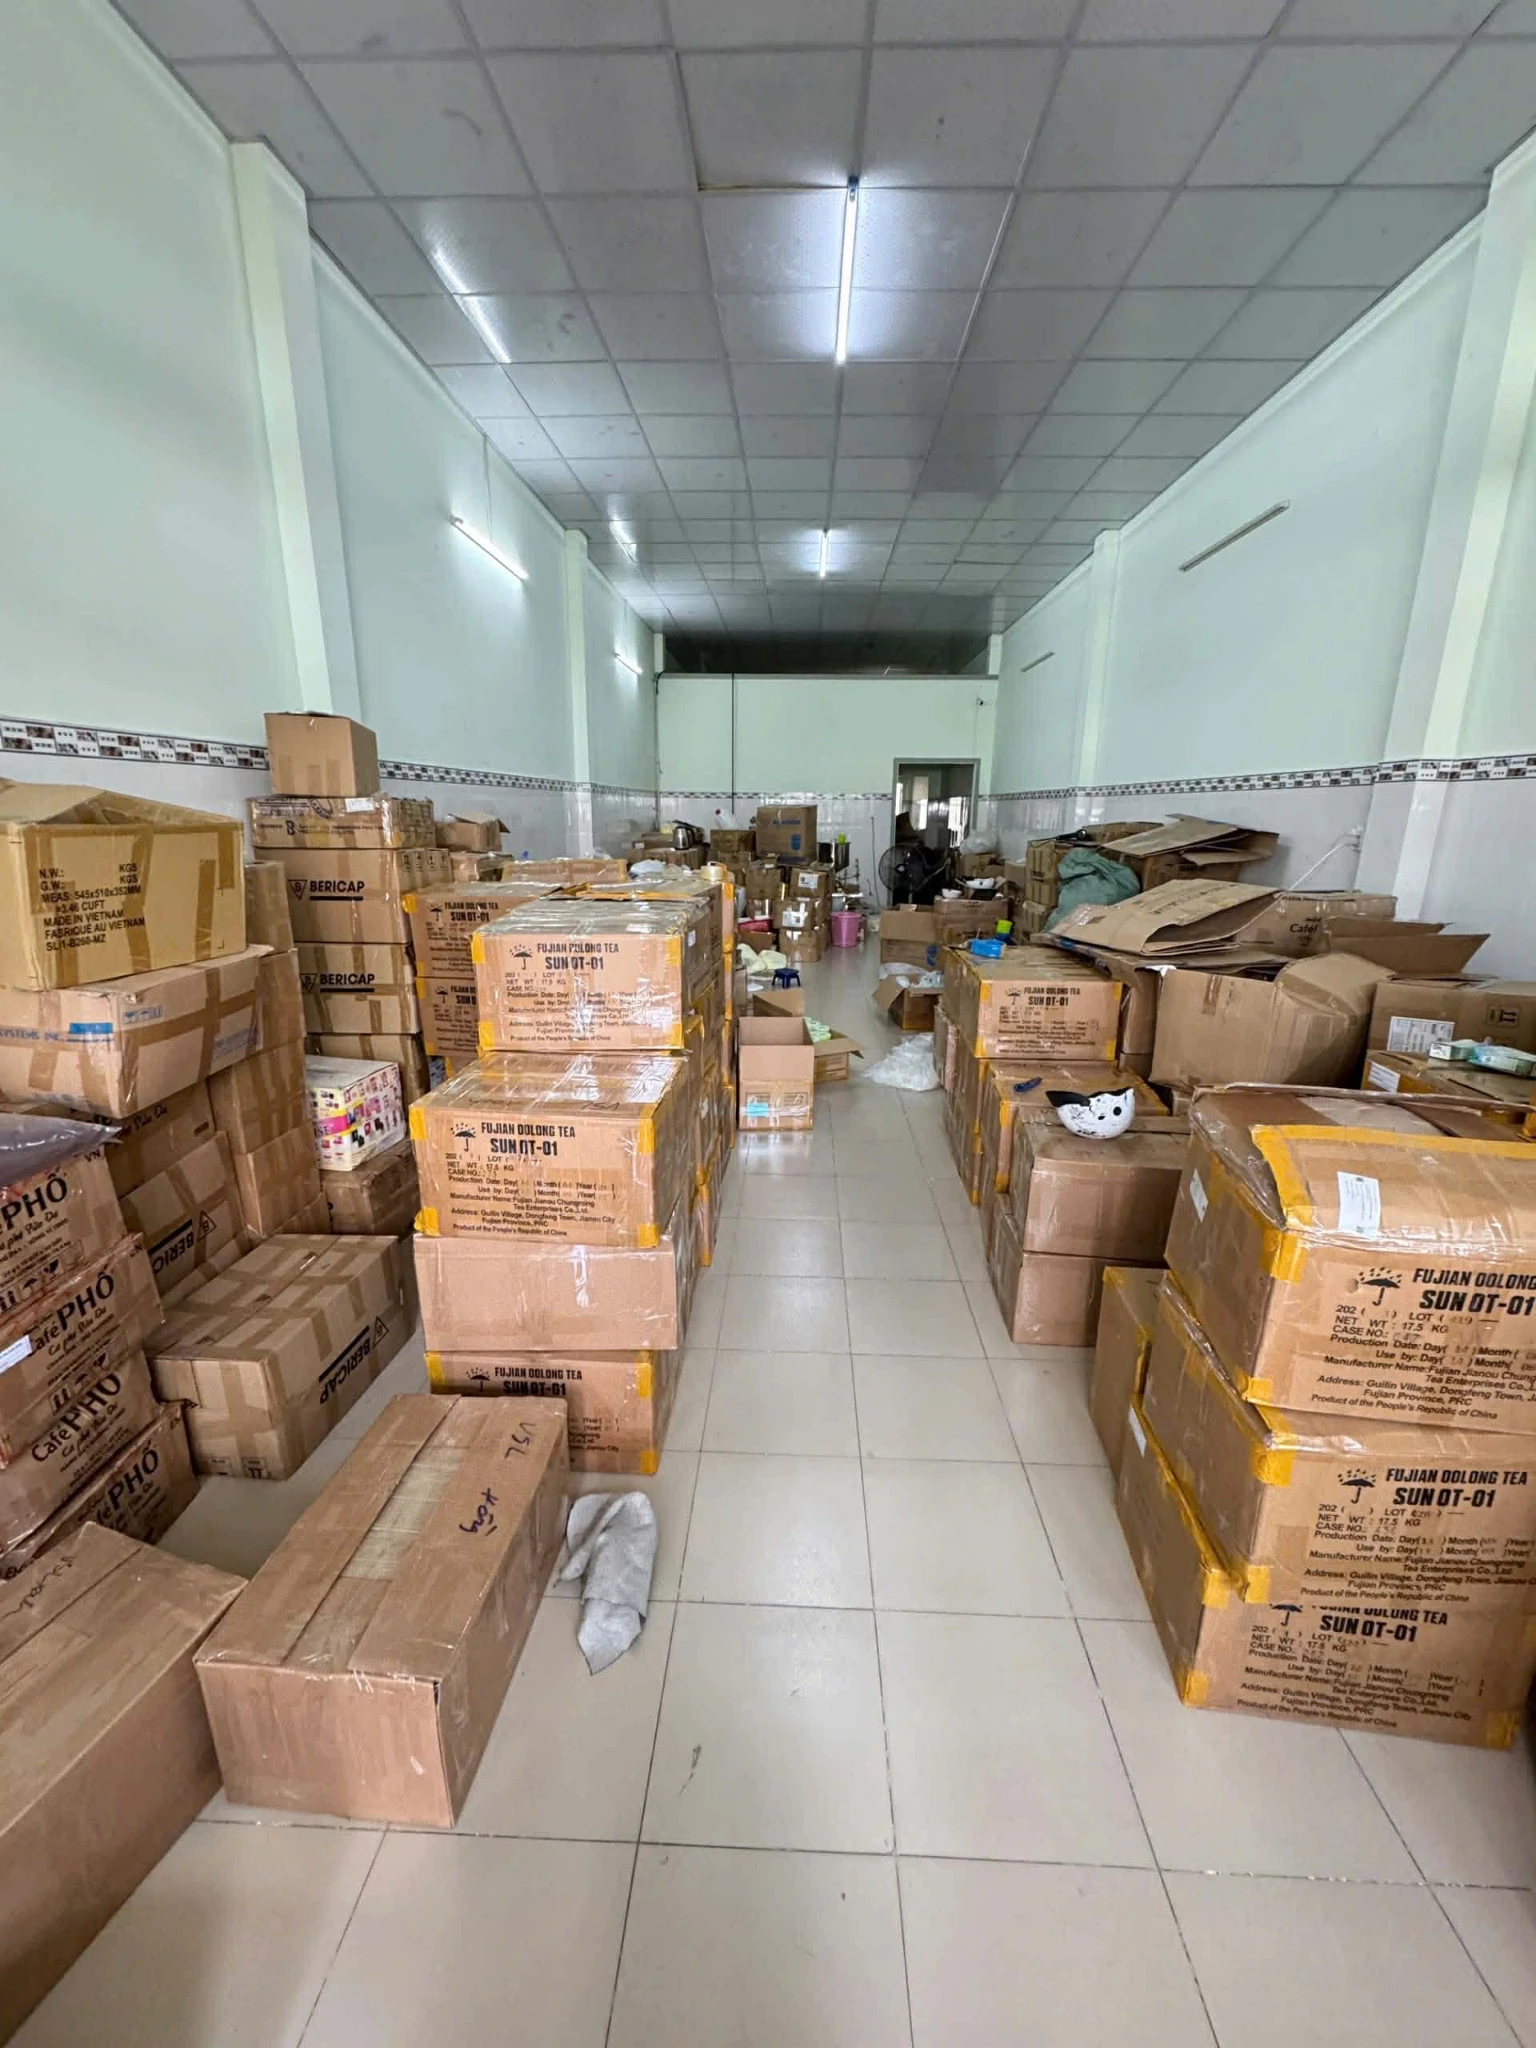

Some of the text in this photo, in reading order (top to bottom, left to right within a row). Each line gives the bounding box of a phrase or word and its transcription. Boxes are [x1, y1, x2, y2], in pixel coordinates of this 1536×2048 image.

[119, 864, 137, 872] KGS
[120, 874, 138, 884] KGS
[310, 880, 365, 892] BERICAP
[81, 899, 105, 911] CUFT
[488, 902, 499, 910] TEA
[43, 909, 124, 927] MADE IN VIETNAM
[451, 912, 490, 922] SUN OT-01
[44, 917, 145, 939] FABRIQUE AU VIETNAM
[537, 943, 567, 953] FUJIAN
[603, 943, 619, 953] TEA
[545, 955, 604, 970] SUN OT-01
[319, 973, 375, 986] BERICAP
[1028, 996, 1069, 1006] SUN OT-01
[481, 1122, 575, 1137] FUJIAN OOLONG TEA
[490, 1138, 557, 1156] SUN OT-01
[448, 1175, 482, 1183] Production
[450, 1192, 490, 1200] Manufacturer
[602, 1215, 615, 1224] City
[1412, 1268, 1473, 1286] FUJIAN
[1419, 1290, 1536, 1316] SUN OT-01
[1335, 1304, 1434, 1322] 202 LOT
[1332, 1324, 1364, 1335] CASE
[1335, 1315, 1449, 1334] NET WT 17.5 KG
[1330, 1333, 1422, 1351] Production Date:
[1375, 1349, 1418, 1363] Use by:
[320, 1341, 371, 1404] BERICAP
[494, 1367, 583, 1381] FUJIAN OOLONG TEA
[1324, 1355, 1498, 1379] Manufacturer Jianou
[503, 1381, 567, 1396] SUN OT-01
[1317, 1374, 1364, 1386] Address:
[1366, 1379, 1397, 1389] Guilin
[1439, 1385, 1491, 1400] Dongfeng
[1426, 1373, 1505, 1391] Tea Enterprises
[1363, 1387, 1473, 1405] Fujian Province, PRC
[1311, 1394, 1498, 1419] Product the People's Republic of China
[32, 1425, 72, 1463] Café
[1385, 1468, 1528, 1486] FUJIAN OOLONG TEA
[1392, 1487, 1497, 1508] SUN OT-01
[1318, 1503, 1407, 1516] 202 LOT
[1315, 1521, 1344, 1531] CASE
[1317, 1513, 1421, 1527] NET WT 17.5 KG
[1314, 1530, 1367, 1541] Production
[1356, 1543, 1375, 1552] Use
[1309, 1551, 1372, 1562] Manufacturer
[1420, 1563, 1475, 1575] Enterprises
[1349, 1570, 1378, 1580] Guilin
[1414, 1573, 1462, 1584] Dongfeng
[1347, 1579, 1447, 1591] Fujian PRC
[1301, 1587, 1333, 1596] Product
[1444, 1594, 1469, 1602] China
[1423, 1609, 1449, 1625] TEA
[1252, 1625, 1334, 1643] 202 LOT
[1319, 1615, 1418, 1643] SUN OT-01
[1250, 1642, 1276, 1652] CASE
[1251, 1634, 1271, 1643] NET
[1332, 1644, 1348, 1653] KG
